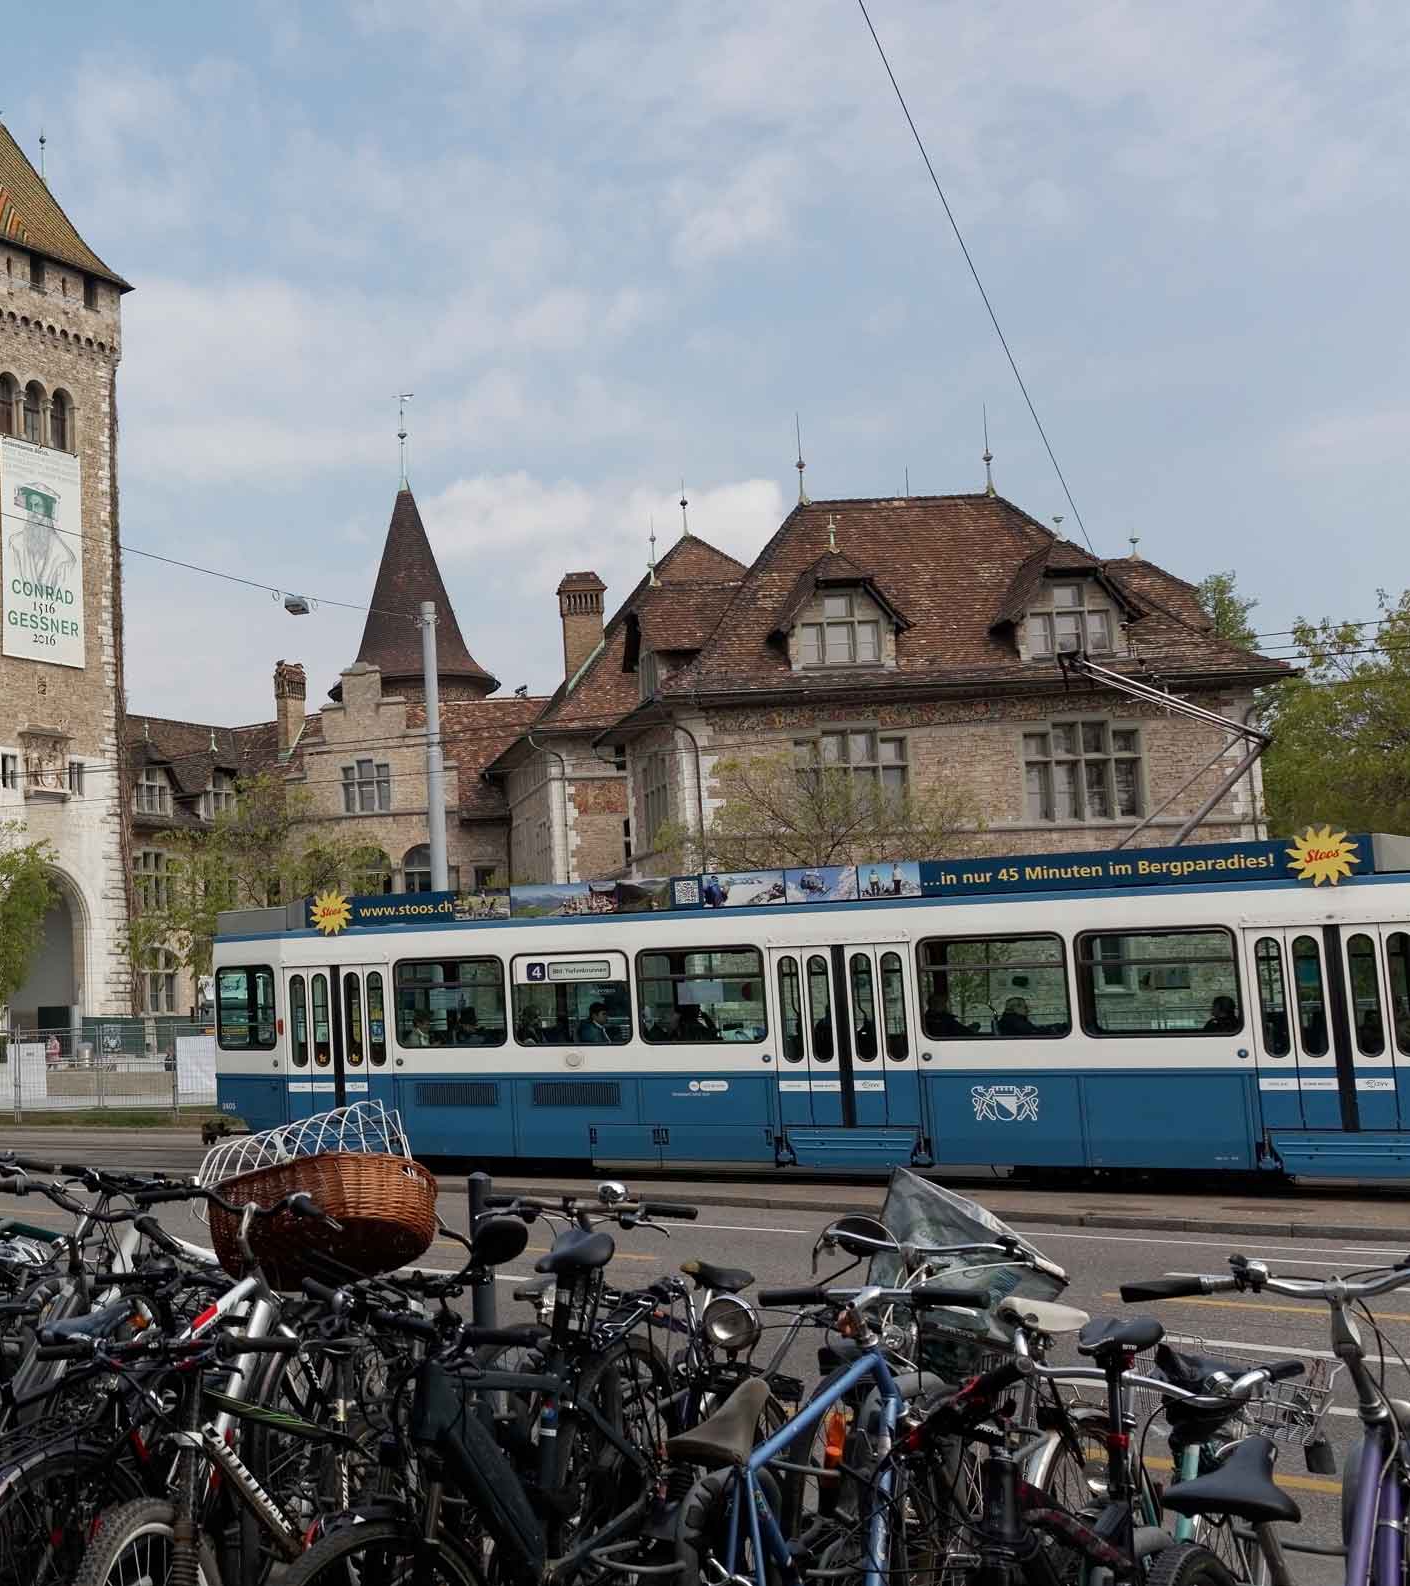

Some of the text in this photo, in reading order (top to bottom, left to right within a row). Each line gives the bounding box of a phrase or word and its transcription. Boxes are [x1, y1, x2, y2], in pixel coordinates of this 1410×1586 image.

[11, 579, 74, 605] CONRAD
[33, 600, 56, 616] 1516
[8, 610, 79, 637] GESSNER
[32, 634, 56, 646] 2016
[1304, 848, 1341, 864] Stoos
[963, 871, 993, 884] nur
[998, 867, 1019, 881] 45
[1025, 863, 1103, 881] Minuten
[1109, 861, 1132, 876] im
[1137, 853, 1275, 876] Bergparadies!
[320, 905, 341, 917] Stoos
[359, 900, 453, 918] www.stoos.ch
[532, 966, 542, 978] 4
